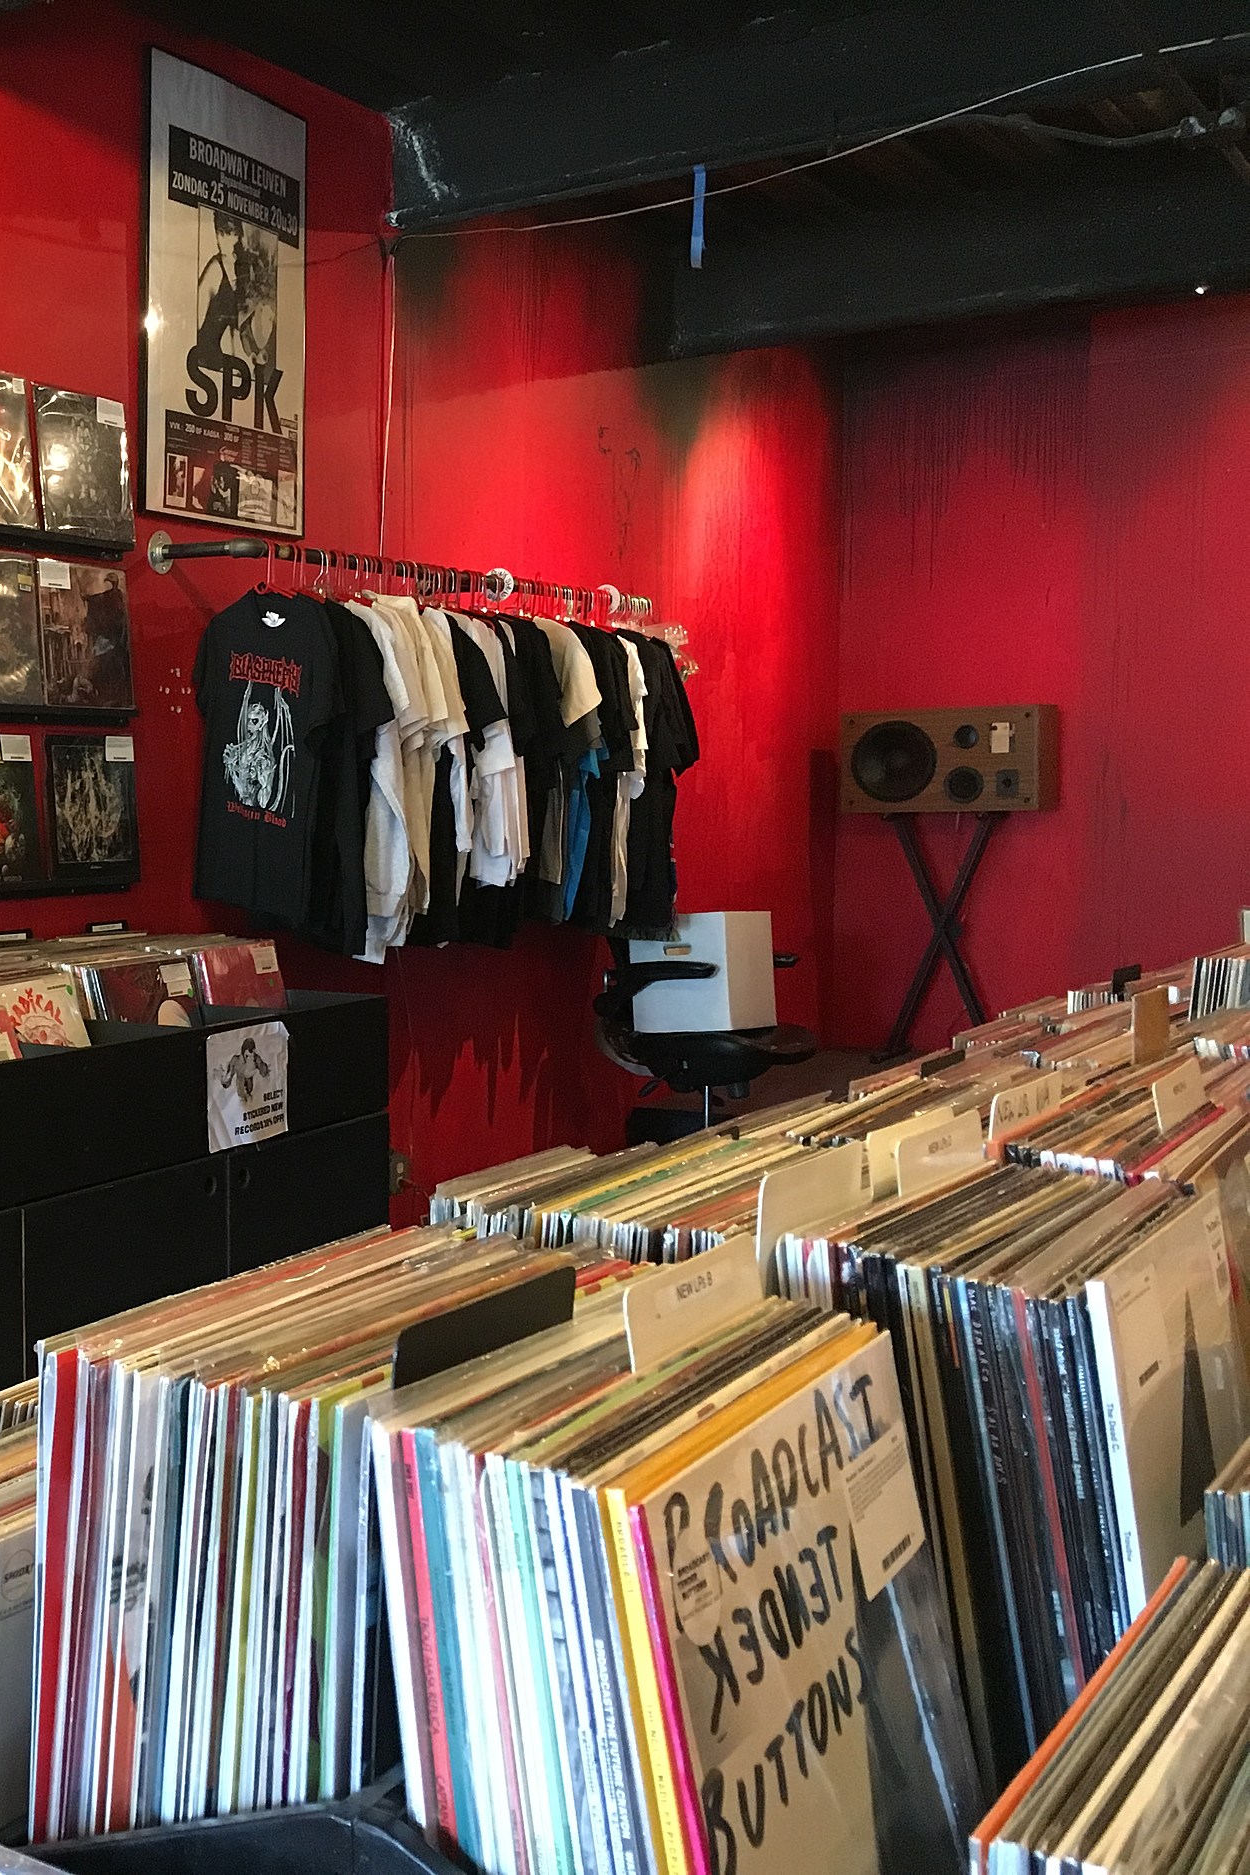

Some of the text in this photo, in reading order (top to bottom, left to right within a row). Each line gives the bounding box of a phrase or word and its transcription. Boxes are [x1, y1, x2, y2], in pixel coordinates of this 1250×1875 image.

[188, 136, 250, 181] BROADWAY
[251, 163, 287, 198] LEUVEN
[171, 170, 209, 199] ZONDAG
[210, 180, 225, 205] 25
[227, 190, 269, 222] NOVEMBER
[270, 205, 298, 236] 20u30
[185, 344, 284, 434] SPK
[263, 1089, 283, 1102] SELECT
[271, 1102, 284, 1112] NEW
[235, 1120, 264, 1136] RECORDS
[675, 1283, 693, 1301] NEW
[693, 1278, 707, 1295] LPs
[967, 1288, 977, 1312] MAC
[1106, 1403, 1114, 1418] The
[594, 1638, 615, 1712] BROADCAST
[606, 1714, 618, 1738] THE
[609, 1740, 623, 1788] FUTURE
[614, 1788, 631, 1839] CRAYON
